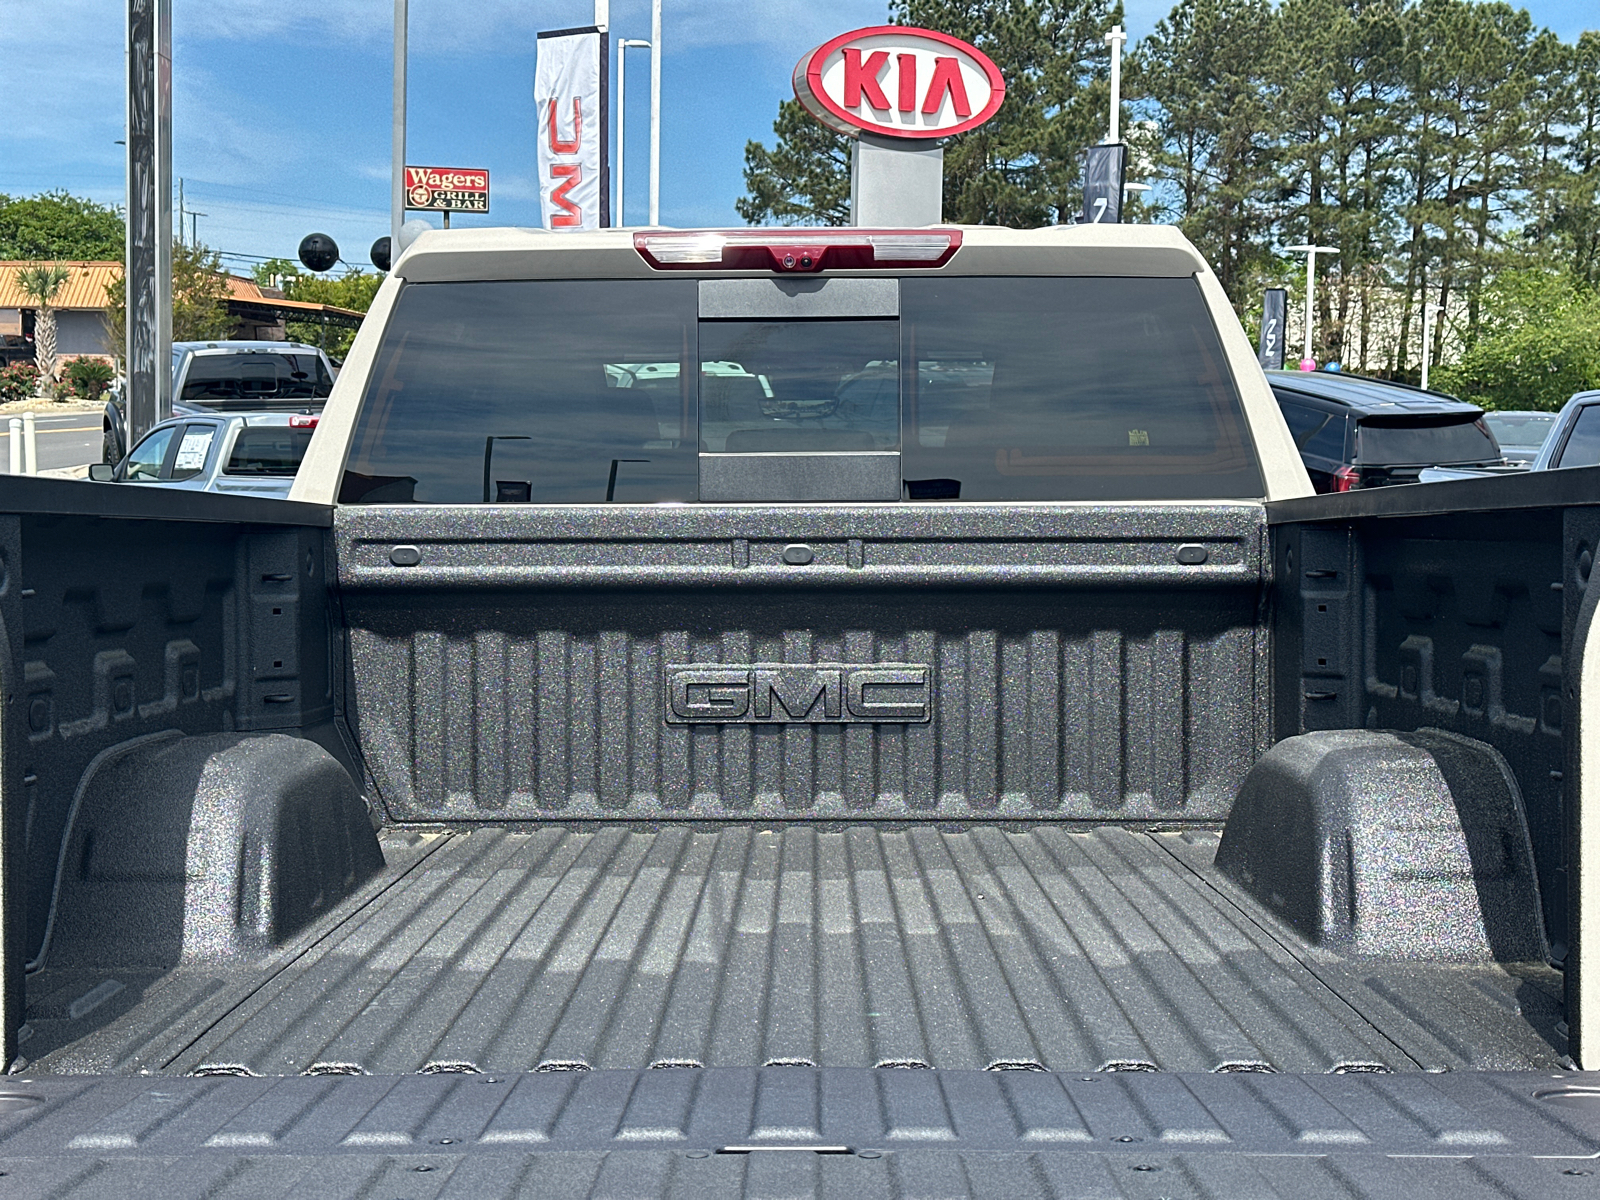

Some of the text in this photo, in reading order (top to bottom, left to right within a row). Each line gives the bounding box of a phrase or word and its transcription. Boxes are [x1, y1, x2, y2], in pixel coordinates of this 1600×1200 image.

[842, 48, 972, 117] KIA
[408, 168, 485, 190] Wagers
[548, 96, 582, 229] MC
[433, 190, 485, 201] GRILL
[433, 199, 485, 209] & BAR
[670, 669, 926, 718] GMC
